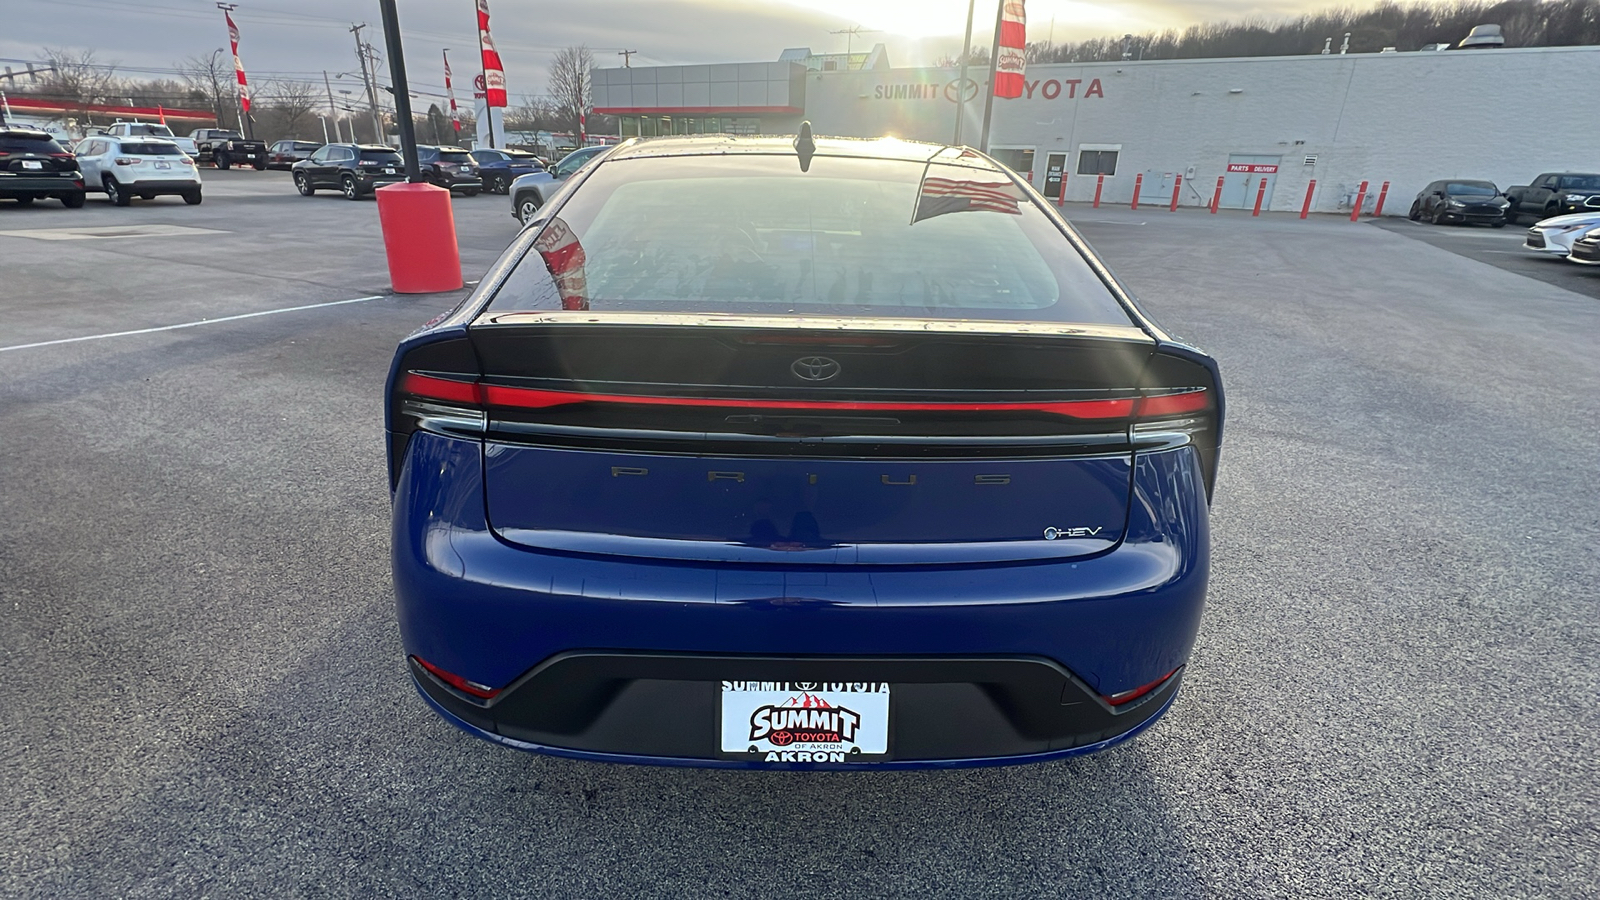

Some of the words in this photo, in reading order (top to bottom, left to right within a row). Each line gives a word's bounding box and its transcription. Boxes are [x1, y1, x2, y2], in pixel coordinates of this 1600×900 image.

[999, 55, 1026, 69] SUMMIT
[875, 84, 939, 100] SUMMIT
[1022, 79, 1104, 100] YOTA
[612, 466, 1011, 485] PRIUS
[752, 707, 858, 740] SUMMIT
[794, 733, 840, 742] TOYOTA
[764, 750, 845, 763] AKRON
